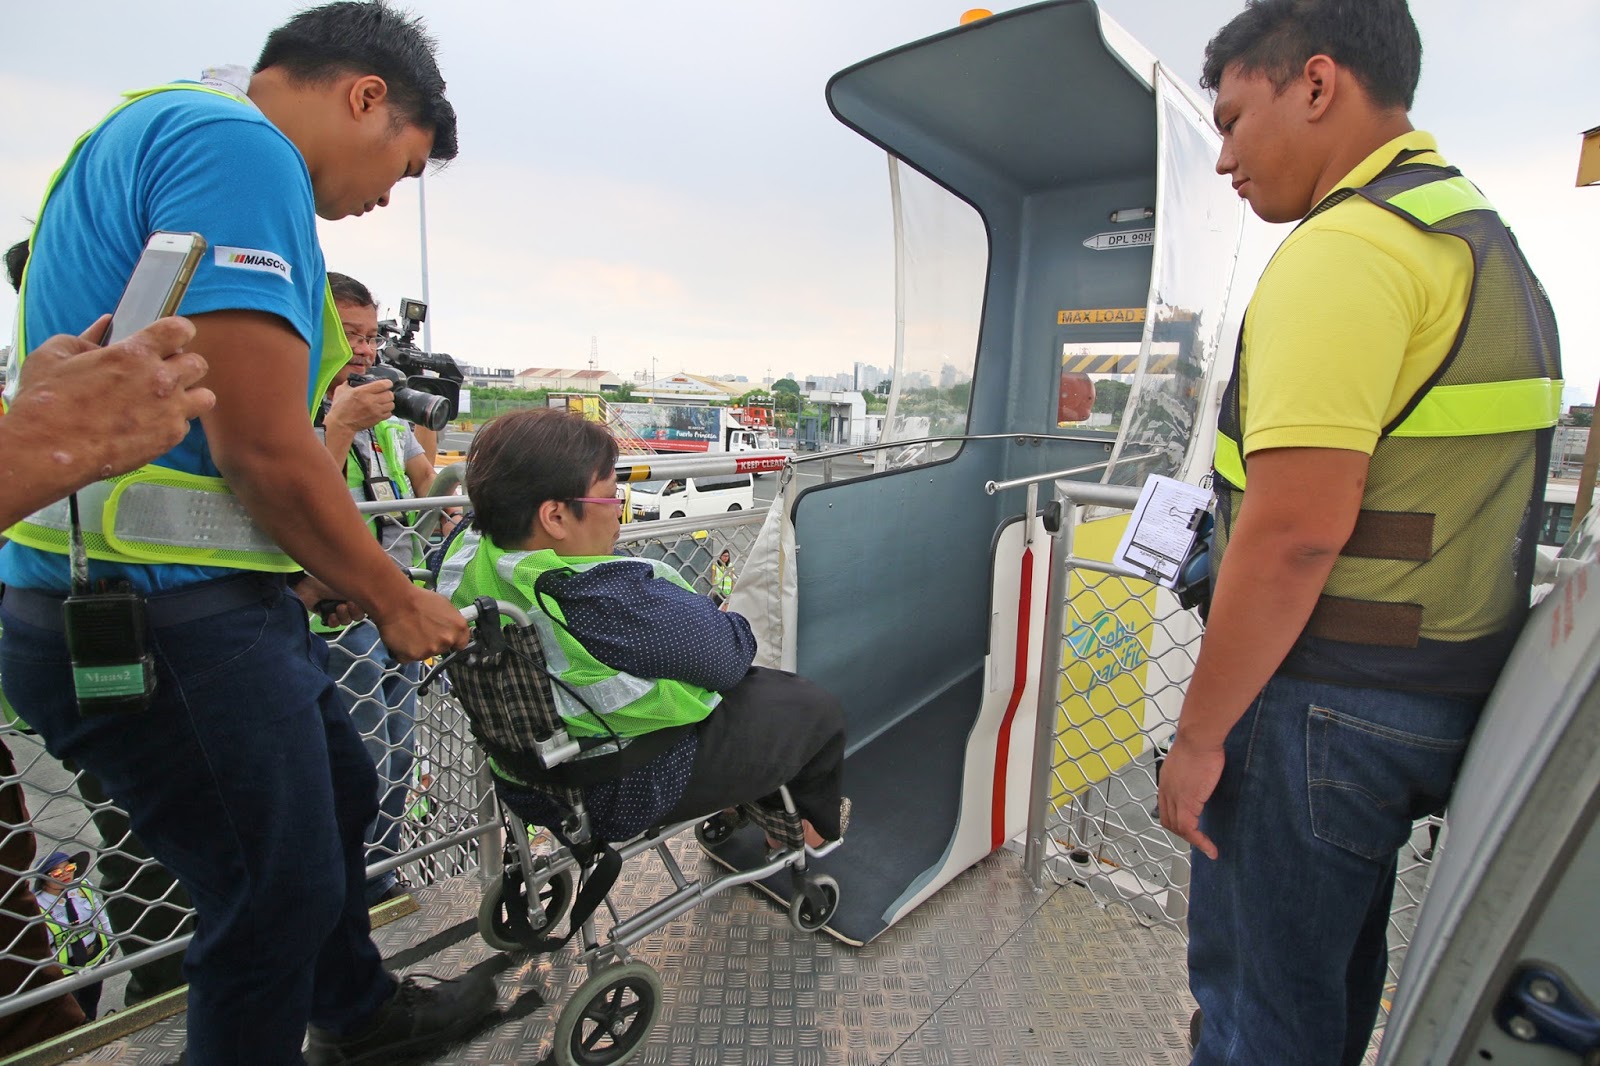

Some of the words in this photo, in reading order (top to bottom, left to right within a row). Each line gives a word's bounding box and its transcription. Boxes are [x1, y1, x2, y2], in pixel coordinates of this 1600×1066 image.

[1108, 234, 1129, 246] DPL
[243, 255, 286, 273] MIASCO
[1062, 311, 1091, 323] MAX
[1095, 309, 1135, 322] LOAD
[676, 430, 693, 438] Puerto
[694, 431, 717, 439] Princesa
[740, 460, 760, 470] KEEP
[761, 458, 785, 469] CLEAR
